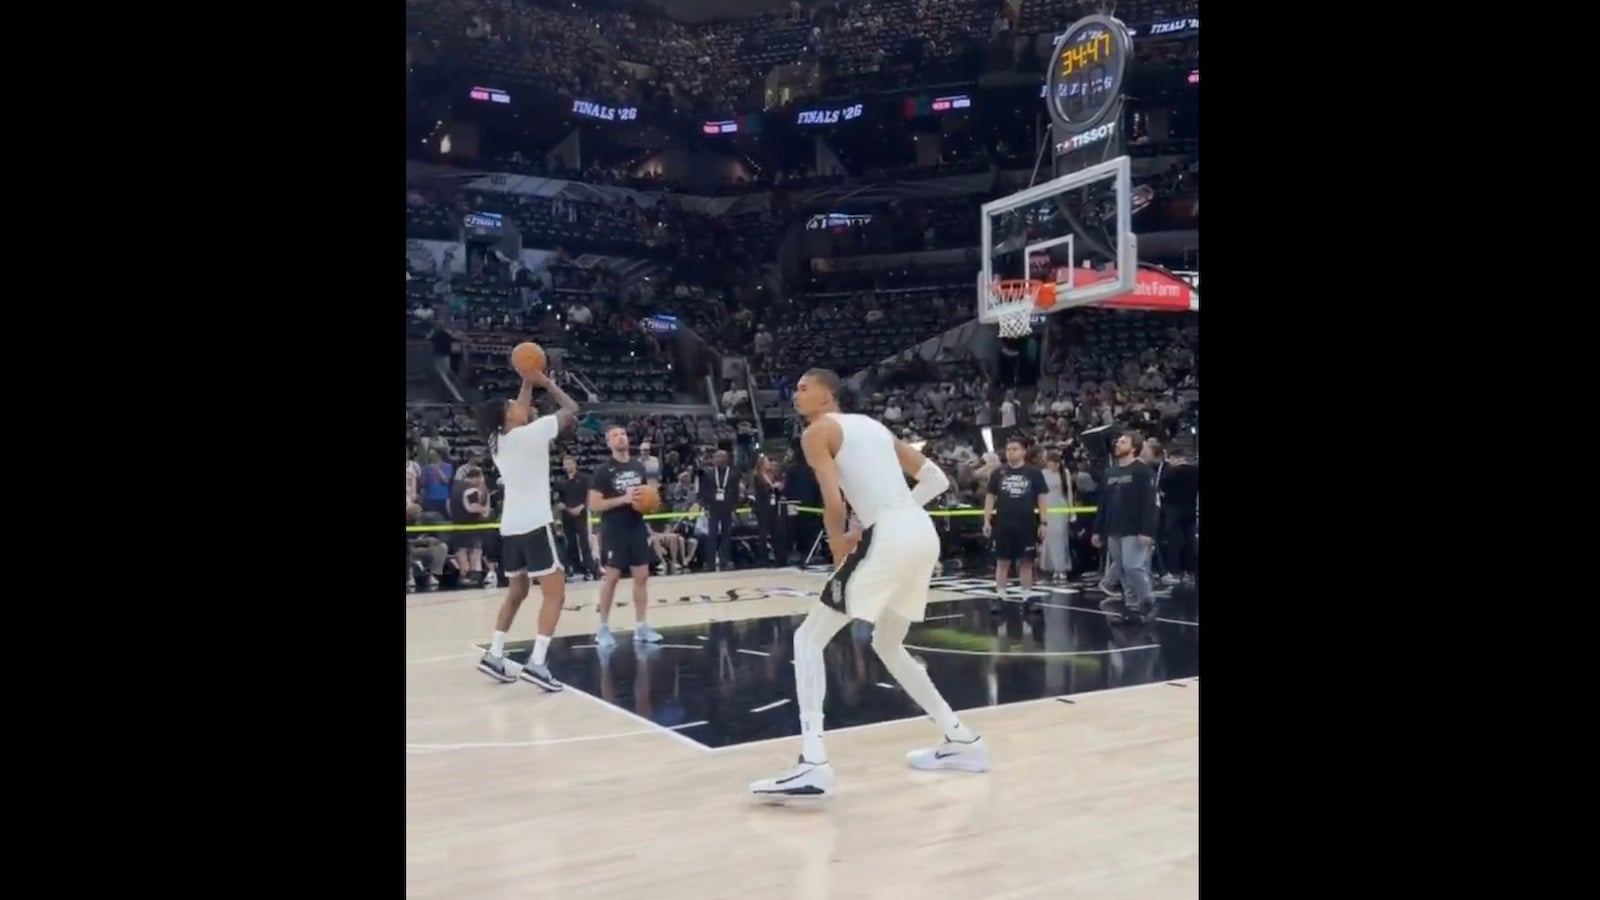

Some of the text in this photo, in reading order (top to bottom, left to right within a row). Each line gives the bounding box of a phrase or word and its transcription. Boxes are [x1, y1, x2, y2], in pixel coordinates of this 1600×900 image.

[1150, 19, 1186, 34] FINALS
[1062, 33, 1110, 76] 34:47
[572, 100, 638, 120] FINALS '26
[797, 103, 863, 124] FINALS '26
[1072, 122, 1115, 148] TISSOT
[1133, 280, 1180, 297] ateFarm
